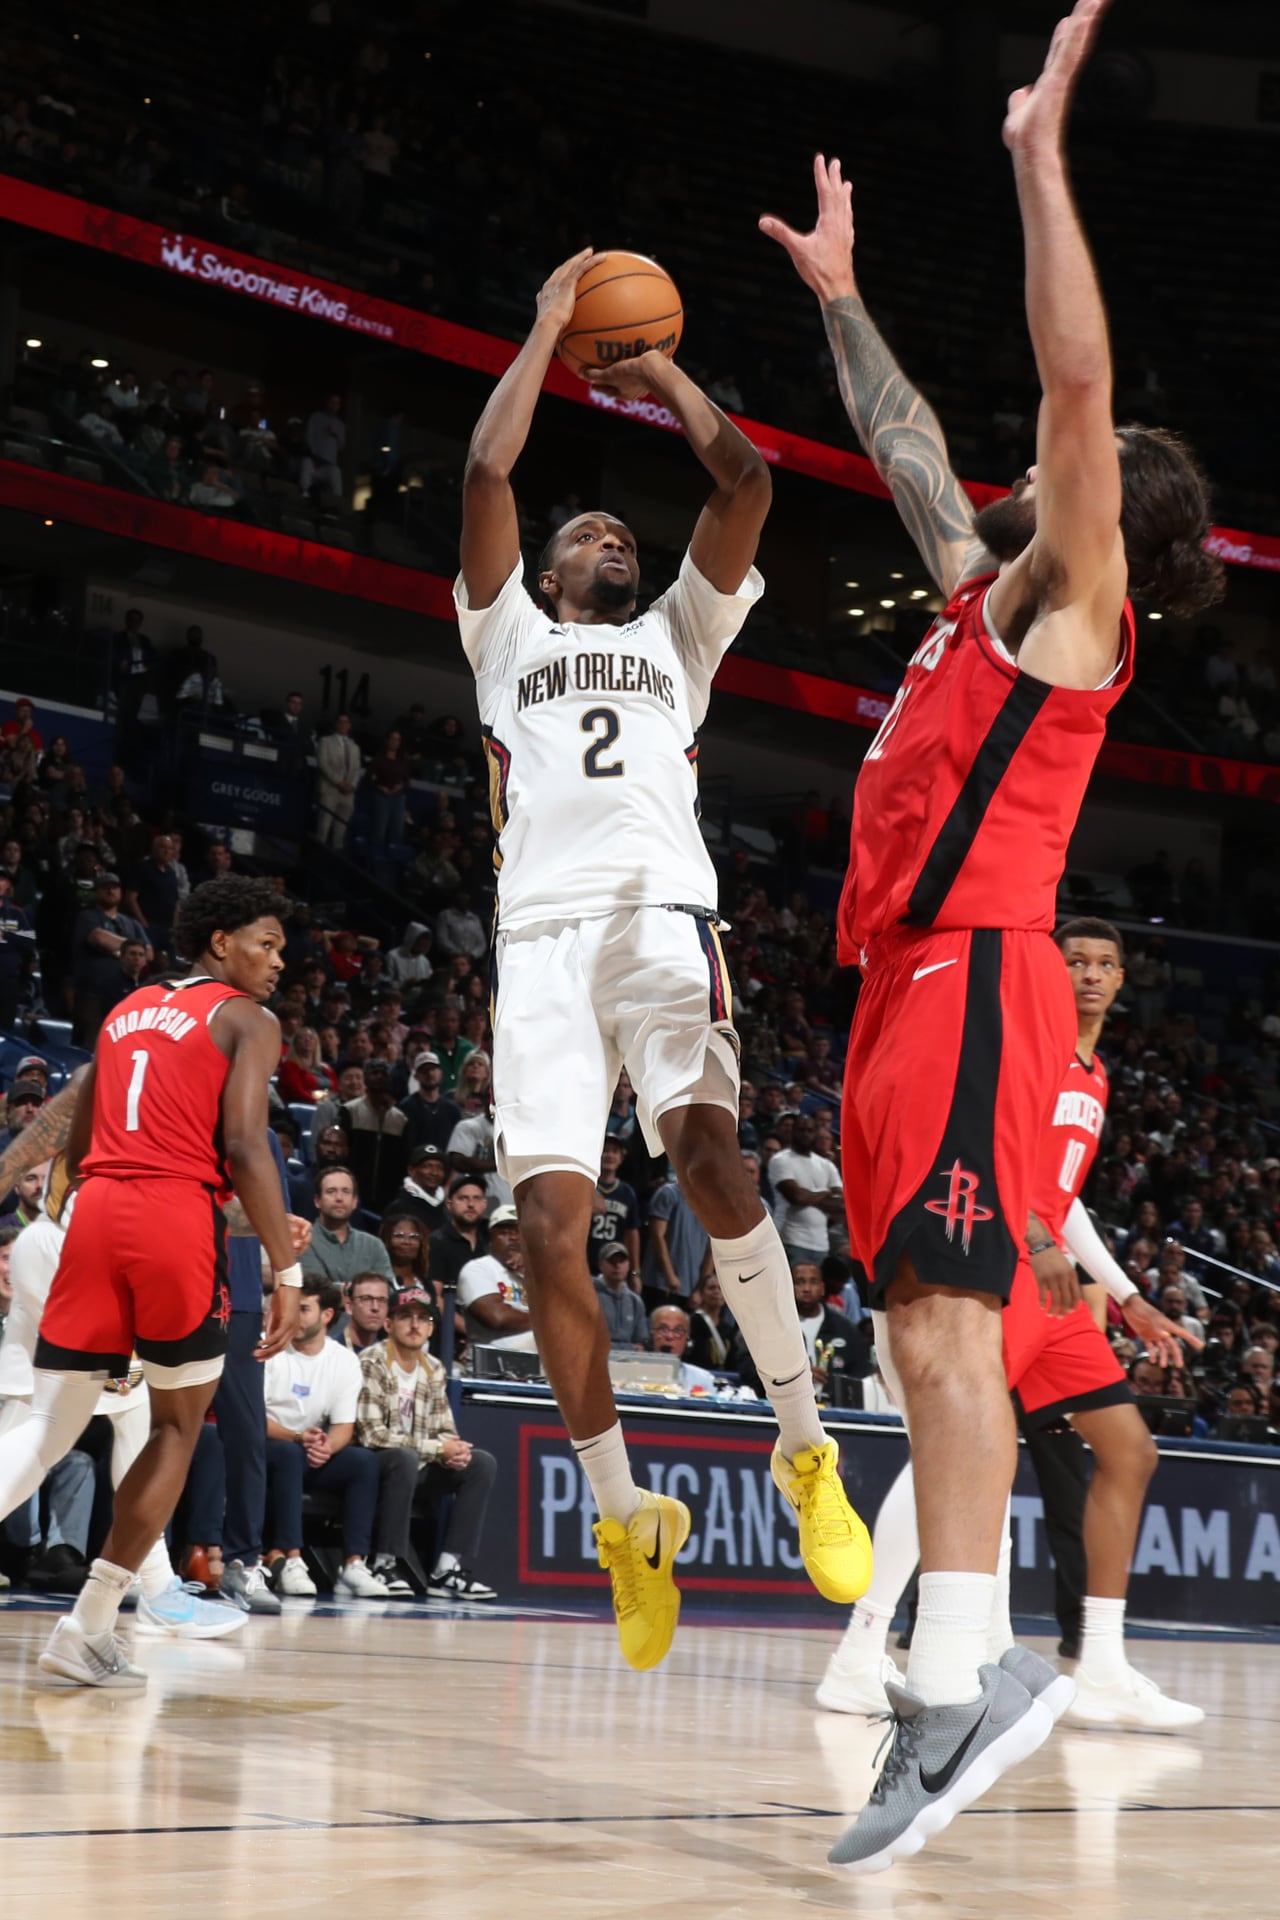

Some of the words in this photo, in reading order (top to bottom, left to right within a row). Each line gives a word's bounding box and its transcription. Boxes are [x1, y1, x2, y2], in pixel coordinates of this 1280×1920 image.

[320, 664, 372, 718] 114
[517, 656, 568, 713] NEW
[574, 652, 675, 711] ORLEANS
[579, 706, 625, 779] 2
[212, 781, 240, 797] GREY
[243, 789, 281, 806] GOOSE
[106, 1006, 198, 1043] THOMPSON
[126, 1049, 149, 1131] 1
[1058, 1138, 1087, 1193] 10
[592, 1214, 618, 1241] 25
